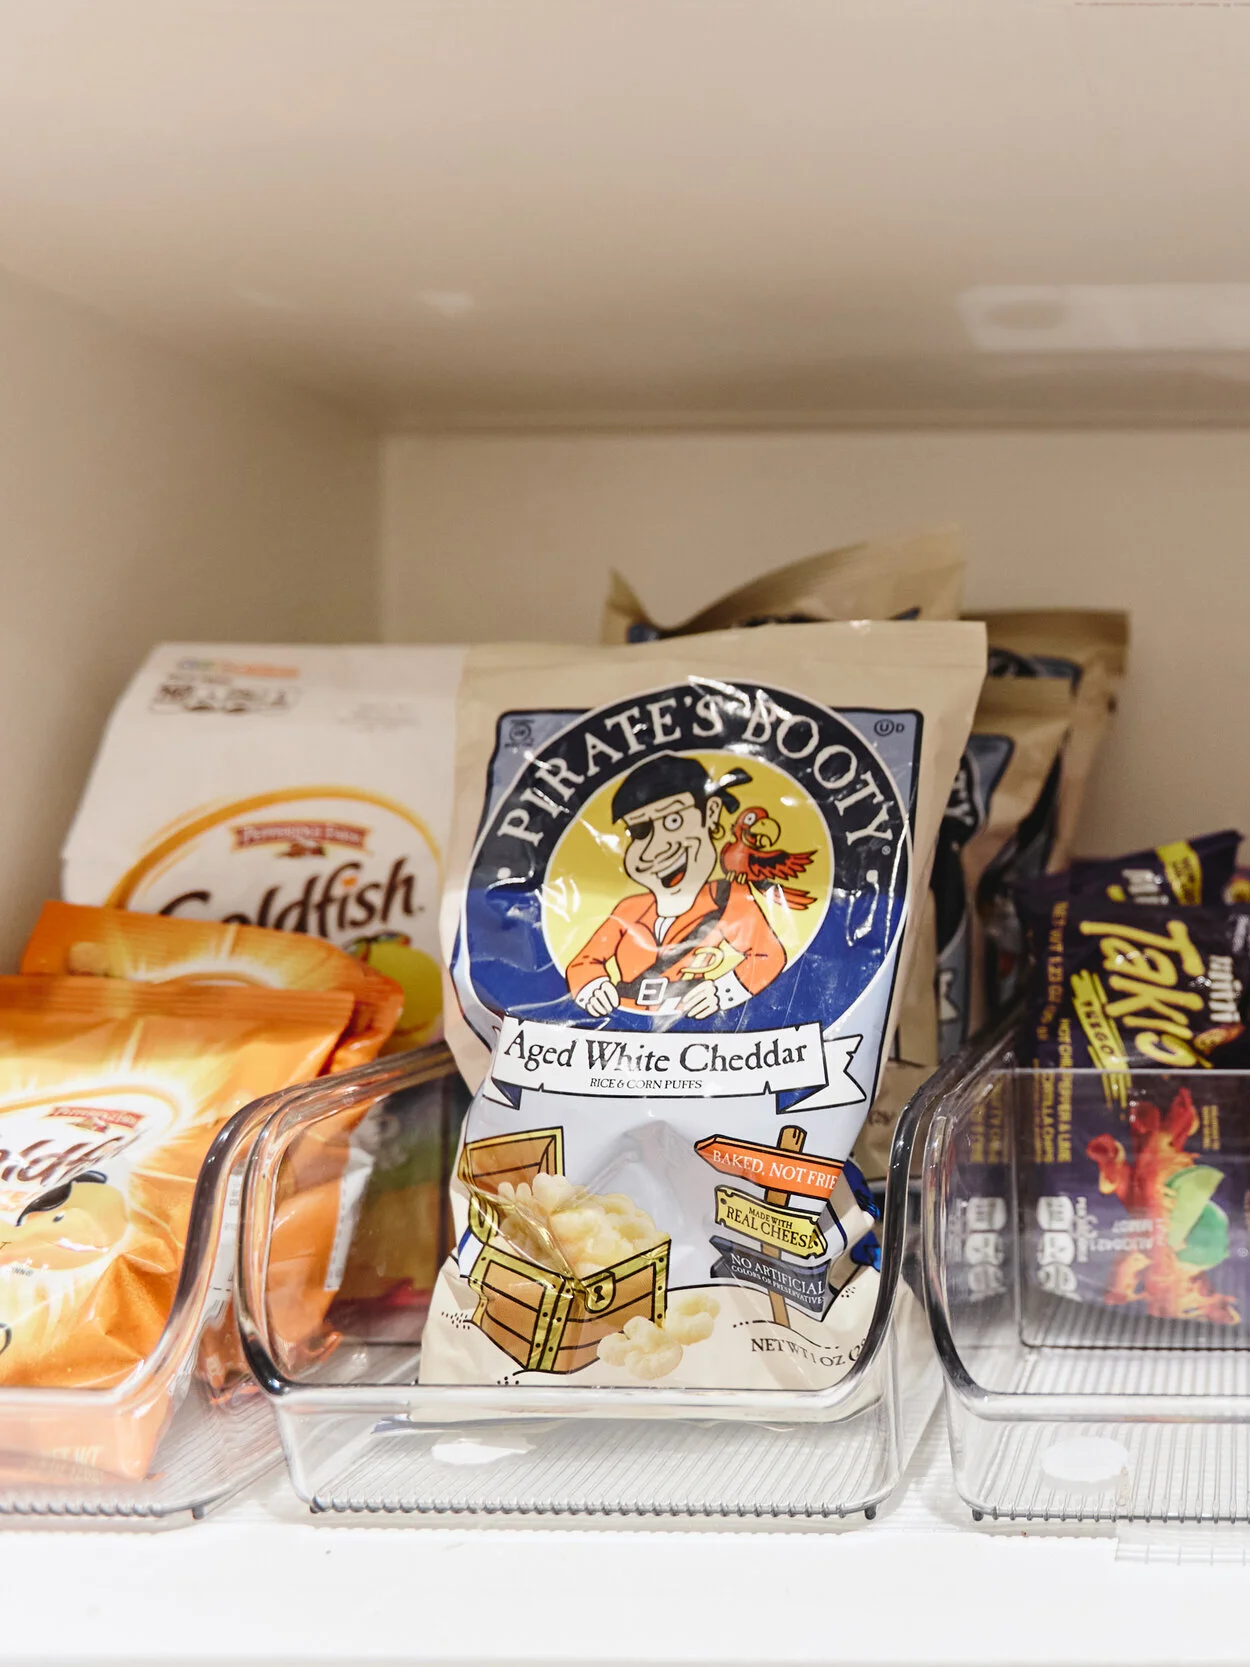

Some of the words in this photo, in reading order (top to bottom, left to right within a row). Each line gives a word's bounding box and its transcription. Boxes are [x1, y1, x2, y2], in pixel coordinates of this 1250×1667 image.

[497, 694, 723, 848] PIRATE'S
[743, 694, 893, 845] BOOTY
[158, 857, 413, 938] ldfish
[1208, 956, 1243, 1023] mini
[504, 1030, 576, 1071] Aged
[585, 1039, 670, 1072] White
[680, 1038, 807, 1072] Cheddar
[590, 1077, 615, 1088] RICE
[617, 1079, 624, 1088] &
[626, 1079, 663, 1089] CORN
[665, 1079, 702, 1089] PUFFS
[769, 1163, 806, 1183] NOT
[806, 1171, 839, 1190] FRIE
[726, 1205, 758, 1231] REAL
[749, 1207, 770, 1222] MADE
[771, 1217, 793, 1230] WITH
[731, 1254, 751, 1268] NO
[755, 1262, 825, 1295] ARTIFICIAL
[773, 1280, 825, 1304] PRESERVATIVE
[751, 1338, 784, 1352] NET
[786, 1341, 808, 1359] WT
[819, 1355, 846, 1367] OZ
